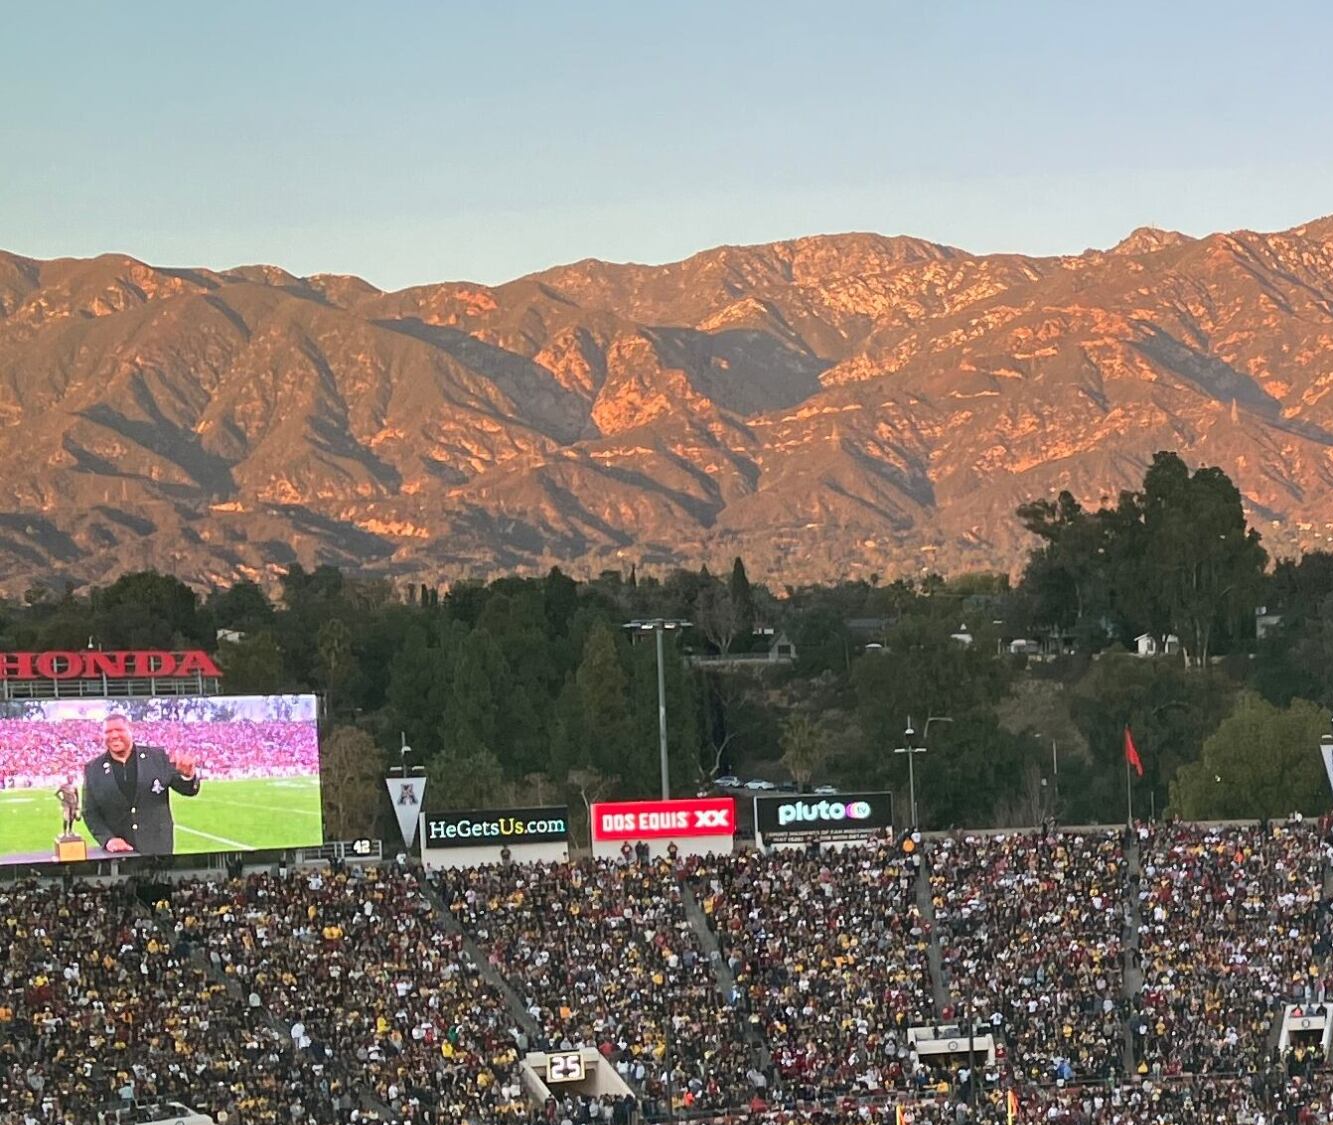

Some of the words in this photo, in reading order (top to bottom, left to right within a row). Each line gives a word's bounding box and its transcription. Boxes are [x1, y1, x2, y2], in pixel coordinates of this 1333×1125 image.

[0, 649, 223, 679] HONDA
[602, 814, 635, 833] DOS
[639, 811, 688, 831] EQUIS
[694, 808, 729, 828] XX
[778, 800, 846, 826] pluto
[429, 817, 566, 840] HeGetsUs.com
[353, 839, 371, 854] 42
[551, 1055, 581, 1081] 25
